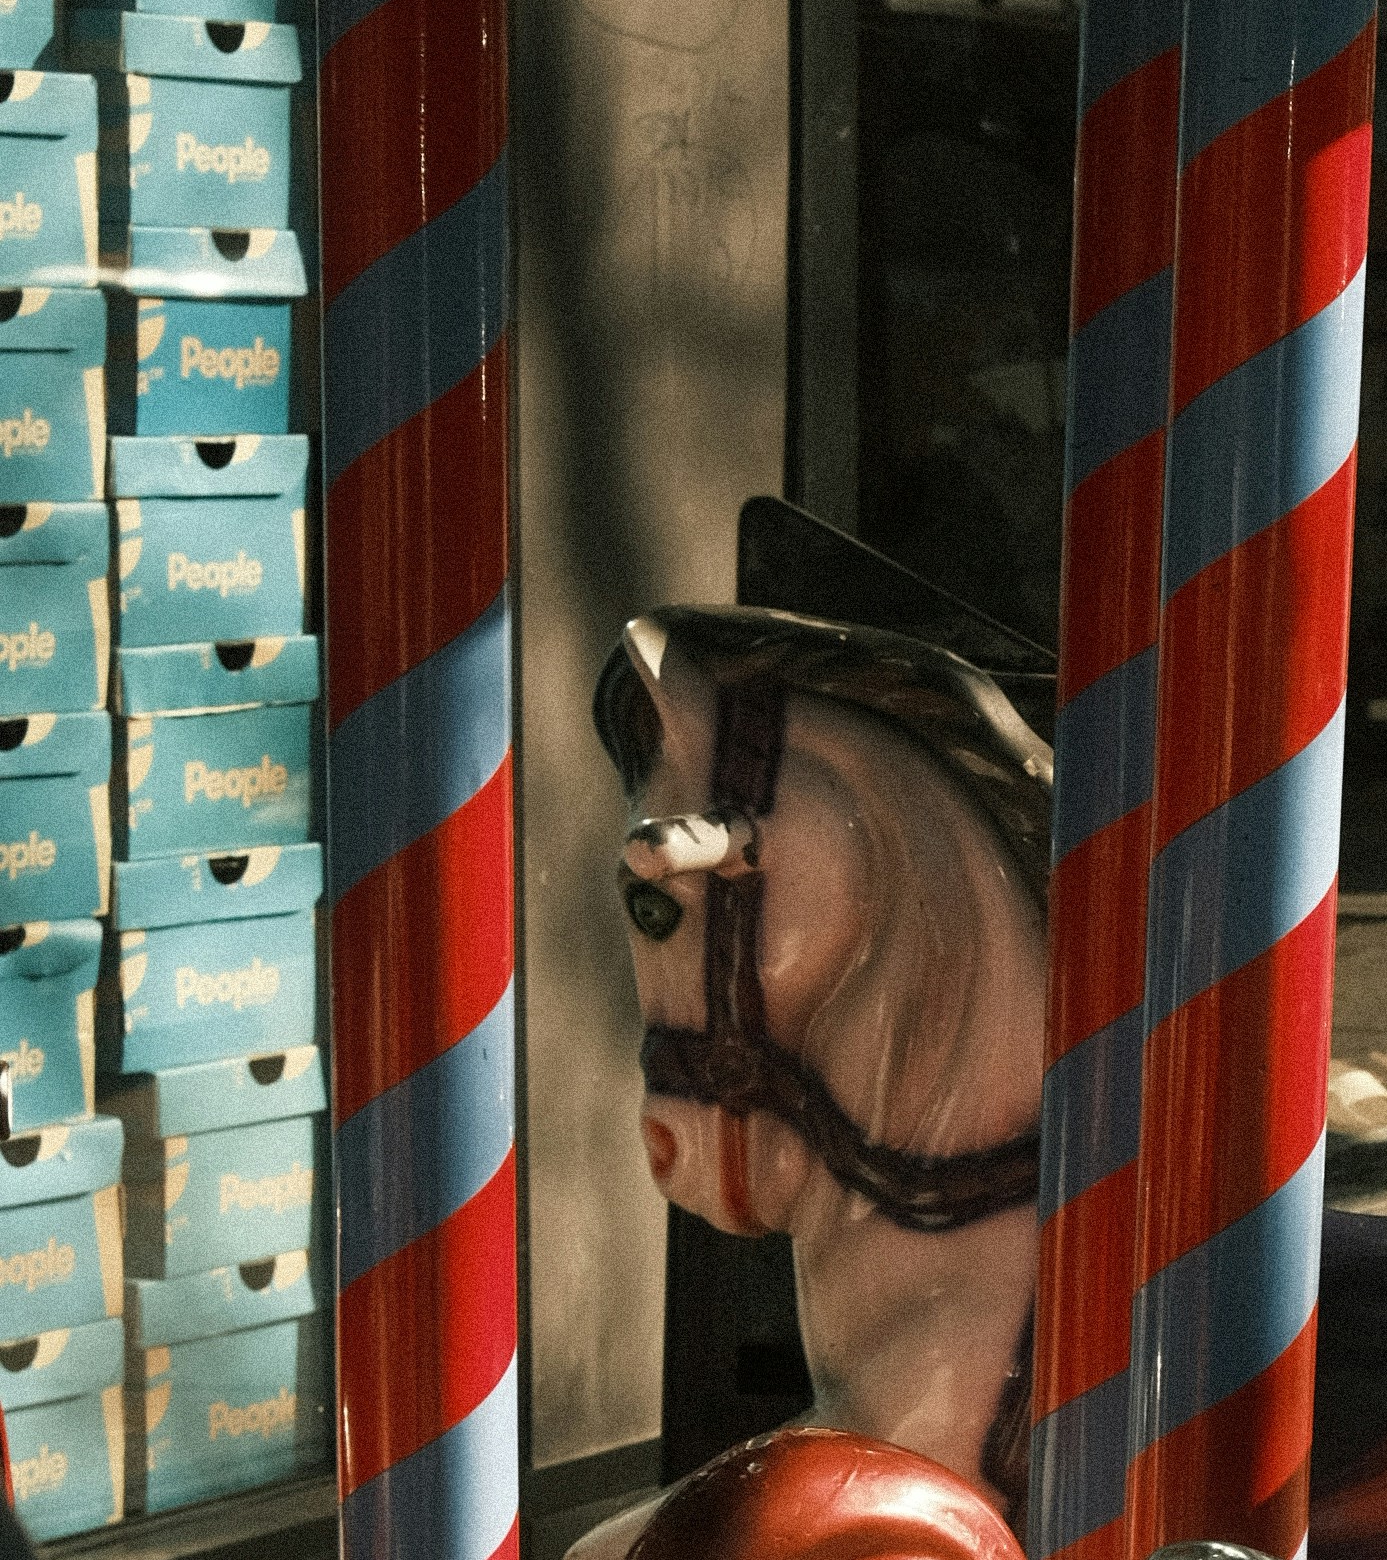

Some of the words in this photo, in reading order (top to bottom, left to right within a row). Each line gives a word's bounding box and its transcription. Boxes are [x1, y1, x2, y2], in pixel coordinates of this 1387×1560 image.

[175, 131, 272, 184] People
[179, 334, 281, 390] People
[166, 550, 264, 598] People
[185, 754, 289, 808] People
[175, 955, 277, 1008] People
